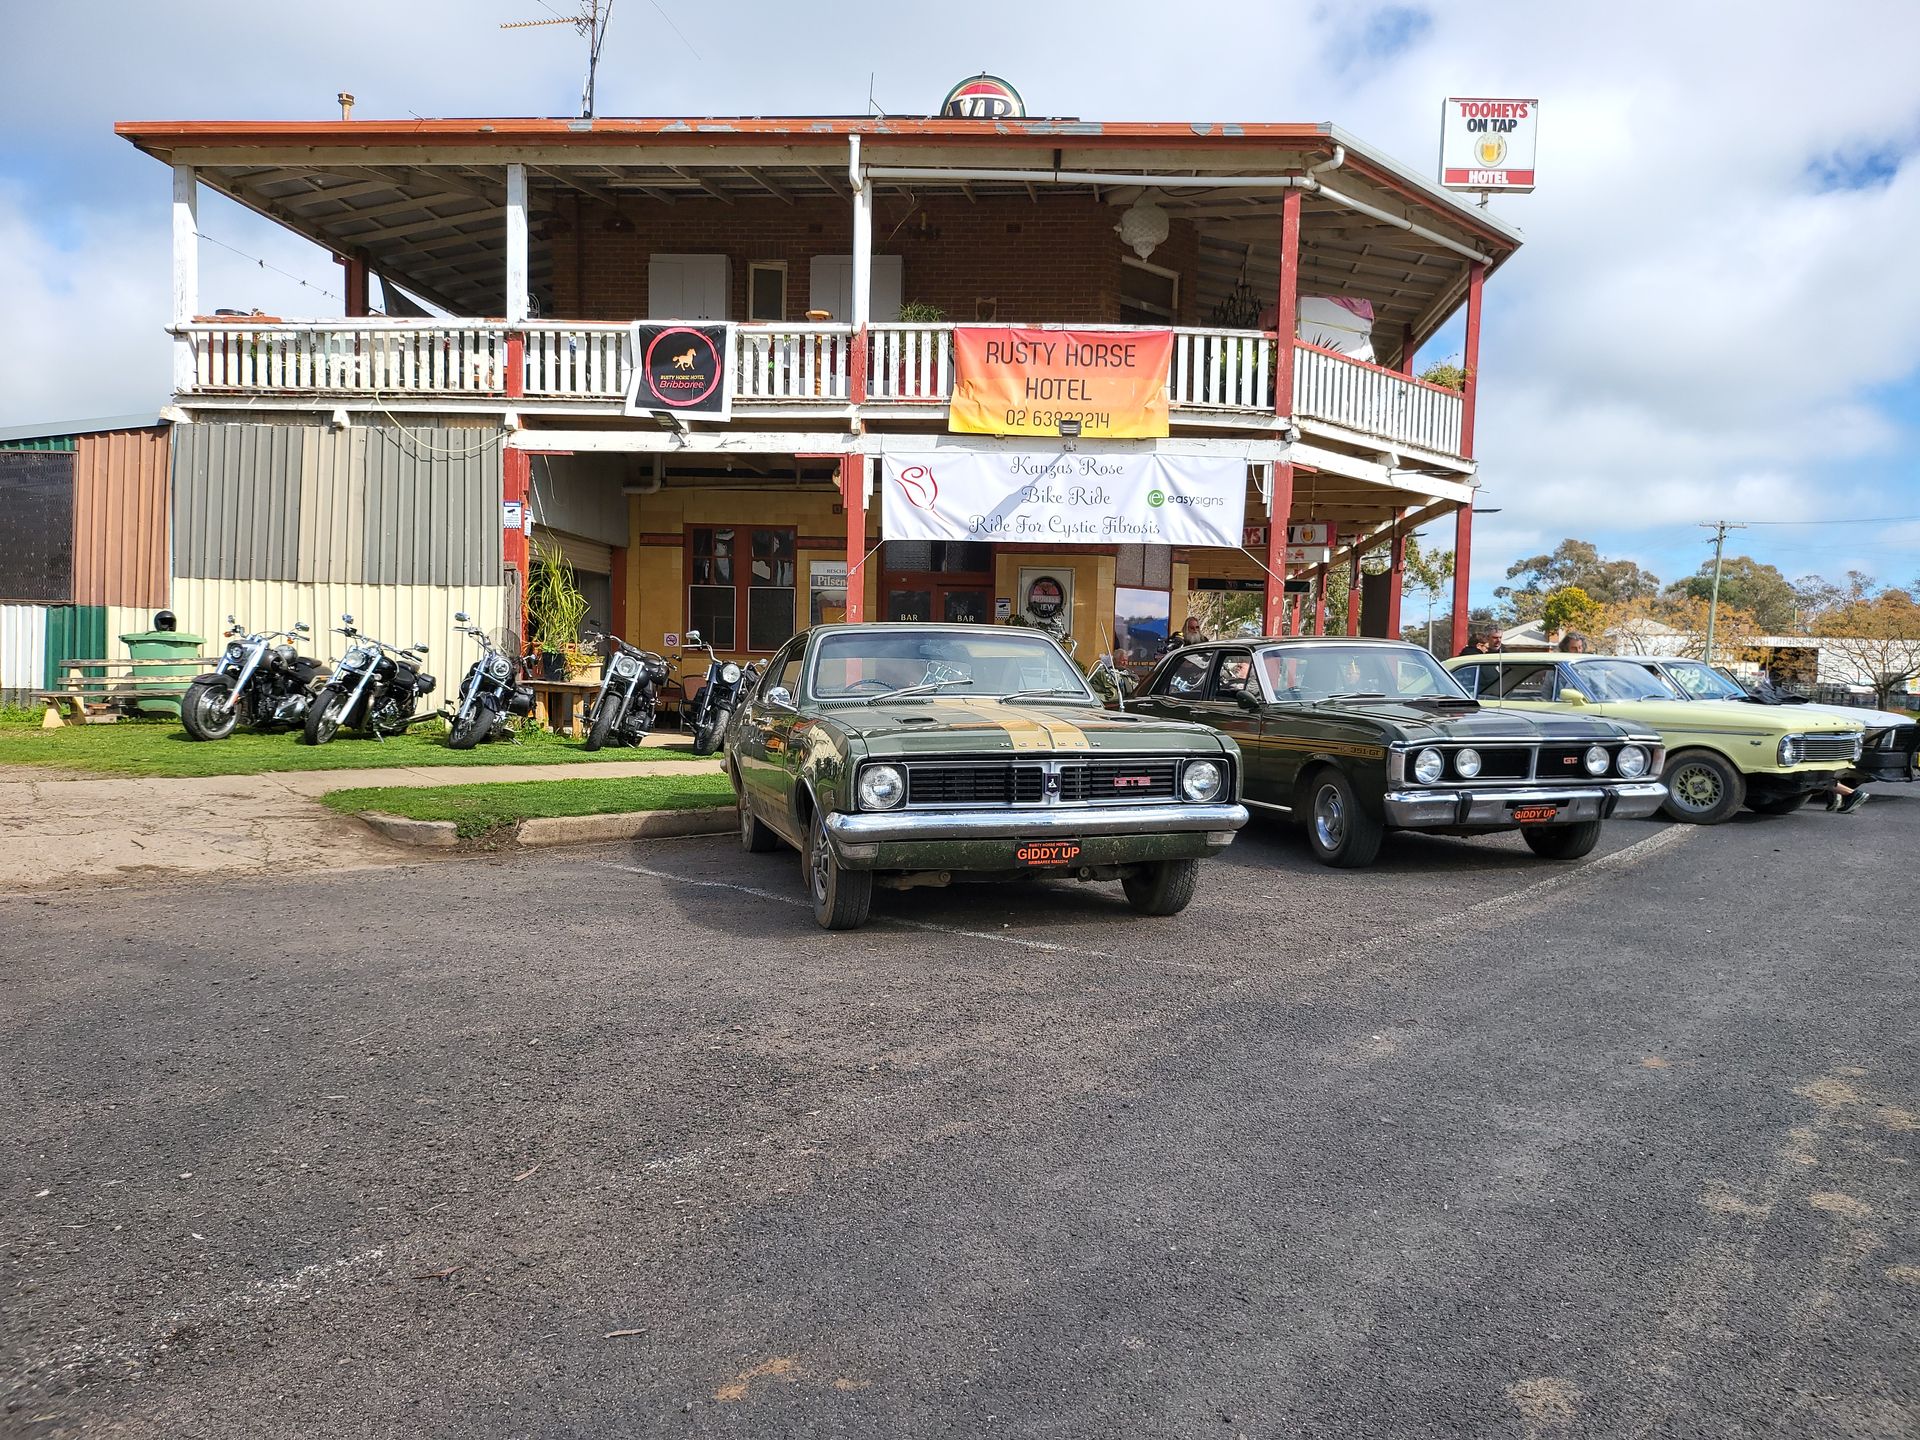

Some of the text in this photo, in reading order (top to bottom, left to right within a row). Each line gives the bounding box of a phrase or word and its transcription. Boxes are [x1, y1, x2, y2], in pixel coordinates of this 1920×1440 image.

[1460, 103, 1528, 118] TOOHEYS
[1467, 119, 1518, 132] ON TAP
[1468, 170, 1508, 184] HOTEL
[985, 341, 1136, 368] RUSTY HORSE
[660, 380, 704, 388] Bribbaree
[1025, 377, 1092, 401] HOTEL
[1006, 409, 1026, 426] 02
[1010, 456, 1126, 479] Kanzas Rose
[1021, 486, 1112, 506] Bike Ride
[1167, 495, 1224, 507] easysigns
[969, 514, 1160, 538] Ride For Cystic Fibrosis
[817, 576, 847, 586] Pilsen
[900, 613, 919, 622] BAR
[957, 614, 975, 623] BAR
[1514, 809, 1556, 819] GIDDY UP
[1017, 846, 1080, 860] GIDDY UP
